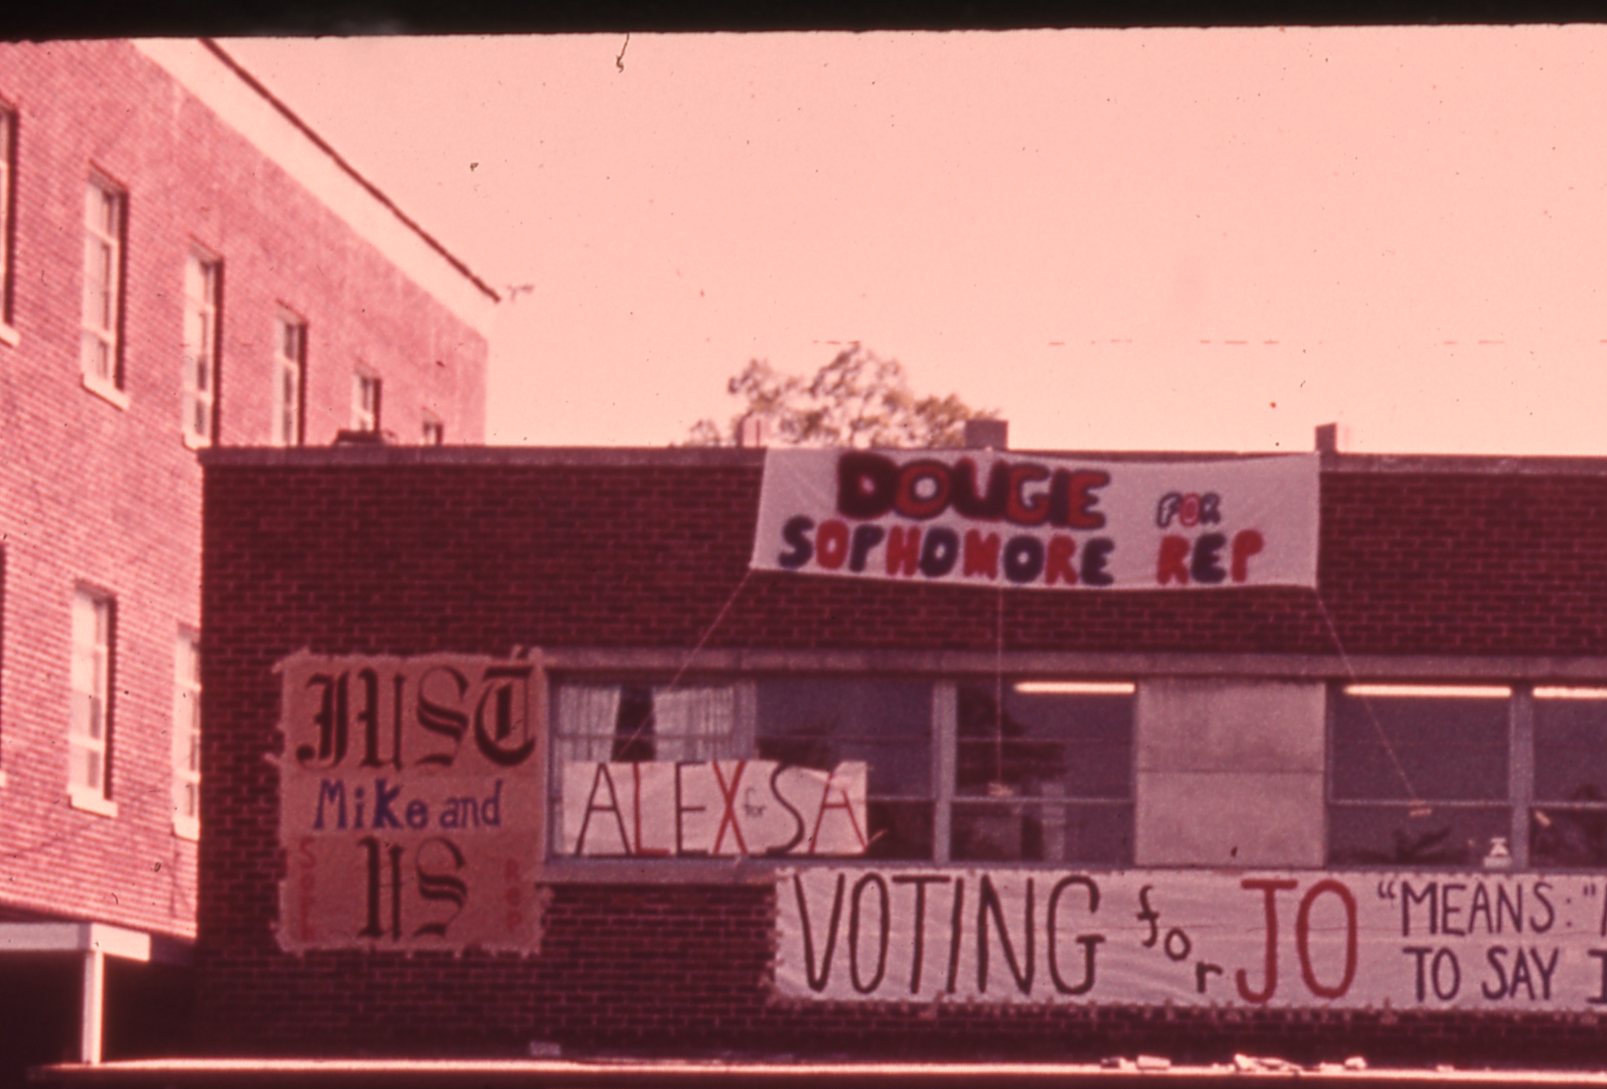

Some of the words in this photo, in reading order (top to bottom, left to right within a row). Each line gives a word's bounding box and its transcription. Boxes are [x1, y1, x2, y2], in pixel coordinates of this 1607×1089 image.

[837, 452, 1111, 531] DOUGIE
[1157, 492, 1221, 527] FOR
[777, 514, 1115, 588] SOPHOMORE
[1156, 528, 1264, 586] REP
[295, 663, 538, 773] JUST
[438, 776, 503, 830] and
[574, 758, 749, 856] ALEX
[766, 759, 869, 856] SA
[355, 834, 470, 942] US
[793, 872, 1107, 996] VOTING
[1135, 884, 1224, 994] for
[1235, 878, 1359, 1004] JO
[1401, 946, 1463, 1003] TO
[1480, 945, 1562, 1003] SAY
